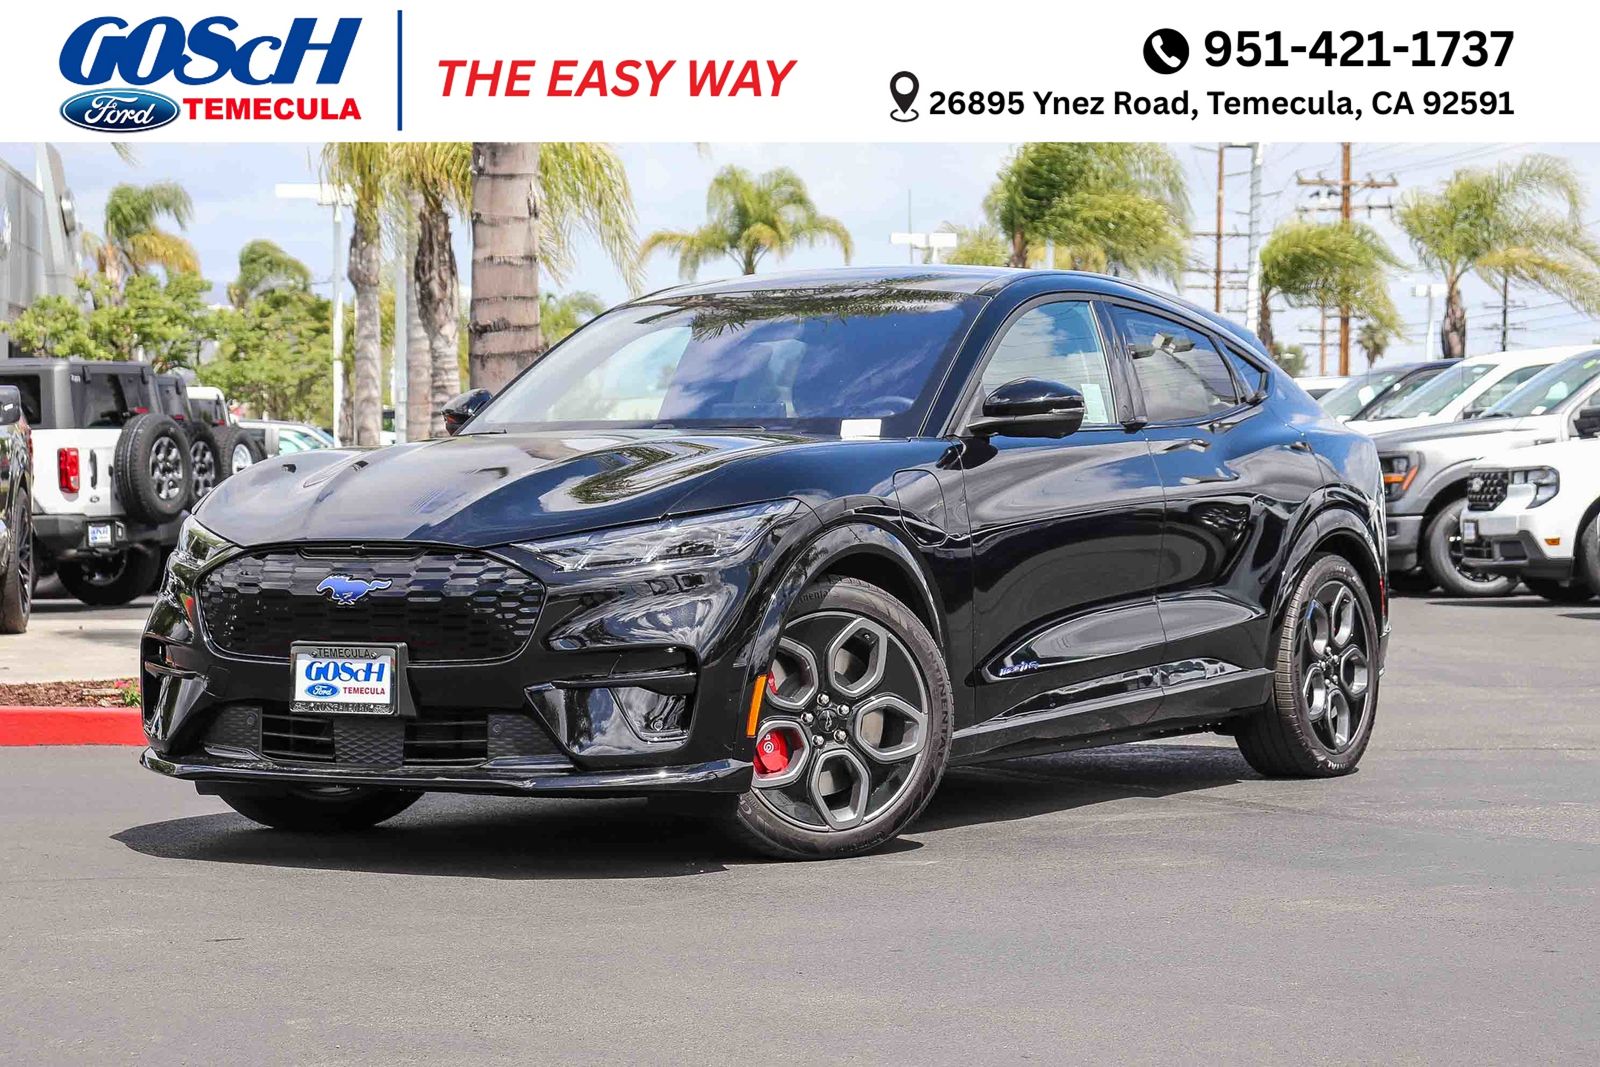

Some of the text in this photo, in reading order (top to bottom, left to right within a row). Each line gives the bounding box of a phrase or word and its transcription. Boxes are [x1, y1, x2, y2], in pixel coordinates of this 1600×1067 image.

[318, 647, 371, 659] TEMECULA
[312, 685, 385, 696] Ford TEMECULA
